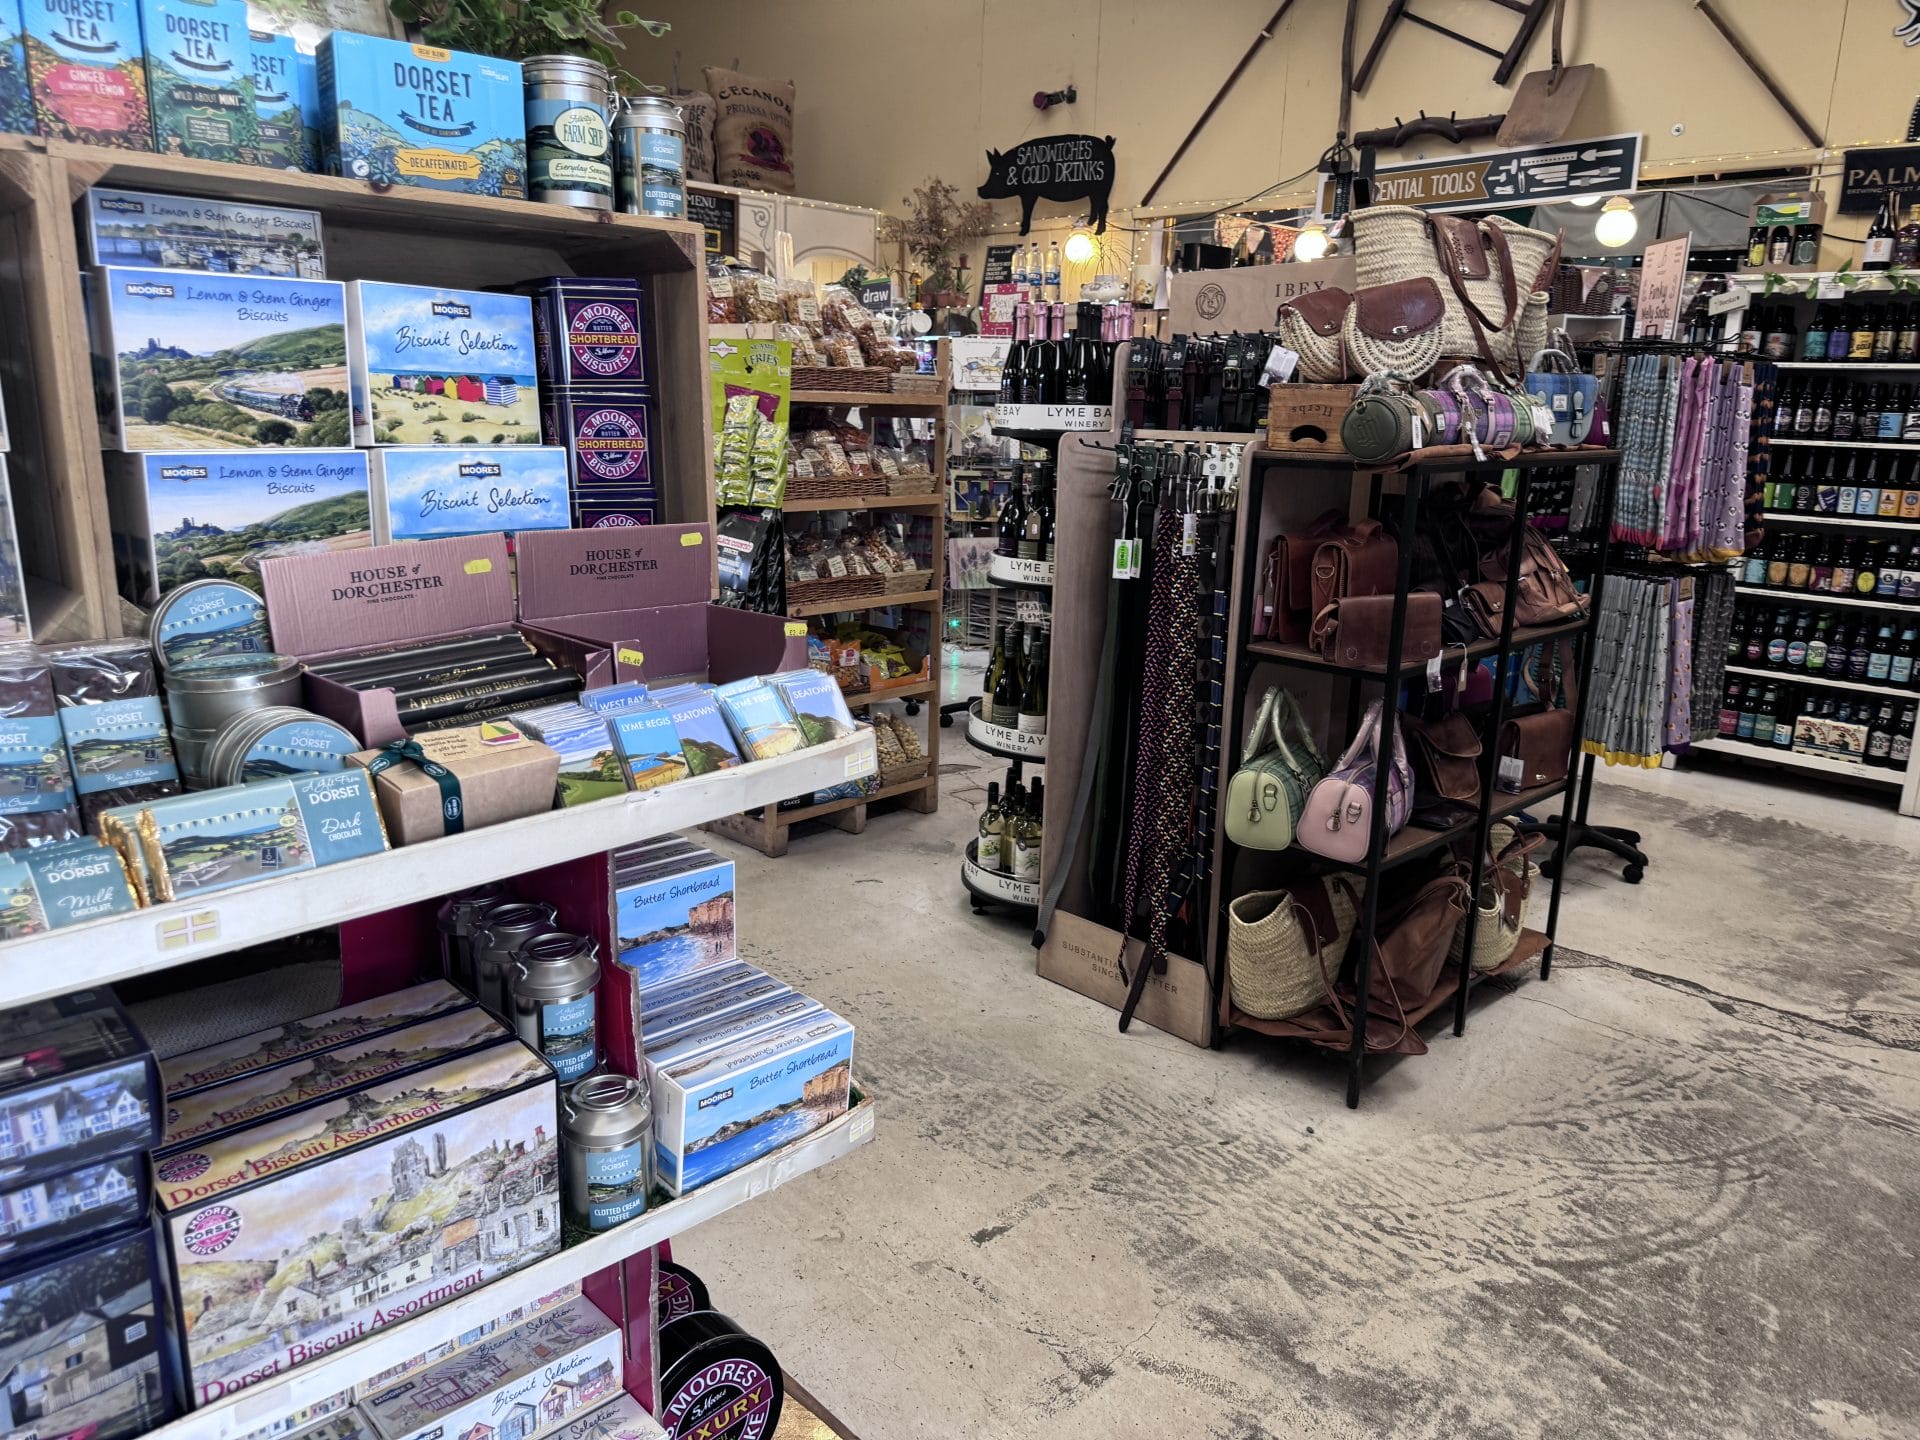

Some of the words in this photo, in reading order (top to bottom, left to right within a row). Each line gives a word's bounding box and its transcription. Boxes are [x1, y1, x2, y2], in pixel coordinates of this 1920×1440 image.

[66, 17, 101, 42] TEA
[165, 14, 230, 42] DORSET
[184, 39, 217, 62] TEA
[69, 69, 106, 84] GINGER
[394, 62, 472, 98] DORSET
[95, 82, 125, 97] LEMON
[219, 94, 241, 107] MINT
[416, 93, 454, 122] TEA
[564, 125, 586, 144] FARM
[1016, 140, 1093, 165] SANDWICHES
[410, 157, 468, 170] DECAFFEINATED
[555, 163, 589, 175] Everyday
[1007, 166, 1018, 185] &
[1021, 164, 1049, 184] COLD
[1055, 161, 1104, 182] DRINKS
[1431, 171, 1476, 196] TOOLS
[101, 200, 143, 212] MOORES
[151, 203, 190, 218] Lemon
[192, 208, 201, 219] &
[204, 210, 233, 223] Stem
[235, 211, 270, 231] Ginger
[273, 216, 312, 230] Biscuits
[127, 285, 173, 296] MOORES
[186, 287, 233, 302] Lemon
[238, 292, 247, 302] &
[252, 290, 286, 304] Stem
[289, 292, 332, 312] Ginger
[862, 287, 889, 304] draw
[237, 307, 289, 322] Biscuits
[434, 305, 470, 317] MOORES
[582, 306, 630, 331] MOORES
[395, 325, 450, 353] Biscuit
[458, 329, 518, 355] Selection
[570, 334, 637, 345] SHORTBREAD
[581, 353, 629, 372] BISCUITS
[750, 353, 778, 366] FRIES
[1047, 407, 1086, 417] LYME
[1094, 408, 1112, 417] BA
[1290, 405, 1333, 417] Herbs
[591, 412, 638, 436] MOORES
[578, 440, 644, 449] SHORTBREAD
[162, 467, 207, 478] MOORES
[219, 465, 263, 480] Lemon
[268, 466, 277, 478] &
[281, 464, 313, 478] Stem
[316, 463, 355, 484] Ginger
[461, 466, 499, 475] MOORES
[589, 458, 636, 476] BISCUITS
[267, 481, 316, 495] Biscuits
[420, 488, 479, 518] Biscuit
[487, 487, 551, 513] Selection
[586, 549, 631, 562] HOUSE
[634, 548, 643, 559] of
[350, 565, 407, 584] HOUSE
[411, 563, 422, 575] of
[570, 560, 658, 576] DORCHESTER
[1010, 561, 1041, 573] LYME
[331, 575, 444, 601] DORCHESTER
[189, 599, 225, 614] DORSET
[409, 698, 419, 709] A
[421, 690, 463, 709] present
[465, 685, 492, 697] from
[600, 699, 626, 712] WEST
[628, 694, 645, 707] BAY
[96, 712, 143, 726] DORSET
[439, 713, 481, 729] present
[483, 705, 509, 716] from
[672, 705, 716, 724] SEATOWN
[621, 720, 644, 733] LYME
[646, 716, 671, 730] REGIS
[290, 737, 330, 749] DORSET
[986, 726, 1012, 741] LYME
[1018, 733, 1045, 745] BAY
[995, 741, 1029, 753] WINERY
[309, 784, 360, 805] DORSET
[321, 812, 362, 834] Dark
[328, 828, 362, 841] CHOCOLATE
[47, 863, 111, 883] DORSET
[633, 890, 666, 909] Butter
[669, 875, 720, 899] Shortbread
[998, 880, 1031, 894] LYME
[57, 887, 114, 910] Milk
[1091, 964, 1120, 981] SINCE
[560, 1010, 585, 1023] DORSET
[776, 1036, 803, 1050] Butter
[190, 1056, 259, 1085] Biscuit
[265, 1025, 370, 1063] Assortment
[577, 1050, 593, 1063] CREAM
[725, 1047, 774, 1069] Shortbread
[563, 1062, 584, 1074] TOFFEE
[750, 1068, 784, 1090] Butter
[786, 1045, 839, 1074] Shortbread
[166, 1118, 214, 1144] orset
[215, 1094, 290, 1126] Biscuit
[298, 1058, 402, 1103] Assortment
[700, 1090, 733, 1108] MOORES
[168, 1167, 248, 1207] Dorset
[249, 1139, 330, 1177] Biscuit
[334, 1097, 443, 1148] Assortment
[602, 1160, 629, 1172] DORSET
[594, 1205, 620, 1216] CLOTTED
[622, 1199, 640, 1212] CREAM
[189, 1206, 234, 1229] MOORES
[608, 1212, 630, 1224] TOFFEE
[184, 1217, 241, 1244] DORSET
[190, 1230, 238, 1255] BISCUITS
[200, 1359, 281, 1404] Dorset
[287, 1323, 367, 1368] Biscuit
[370, 1267, 485, 1330] Assortment
[476, 1331, 519, 1358] Biscuit
[526, 1306, 575, 1335] Selection
[374, 1383, 415, 1405] MOORES
[492, 1380, 538, 1416] Biscuit
[542, 1354, 592, 1388] Selection
[670, 1363, 757, 1417] MOORES
[571, 1405, 621, 1439] Selection
